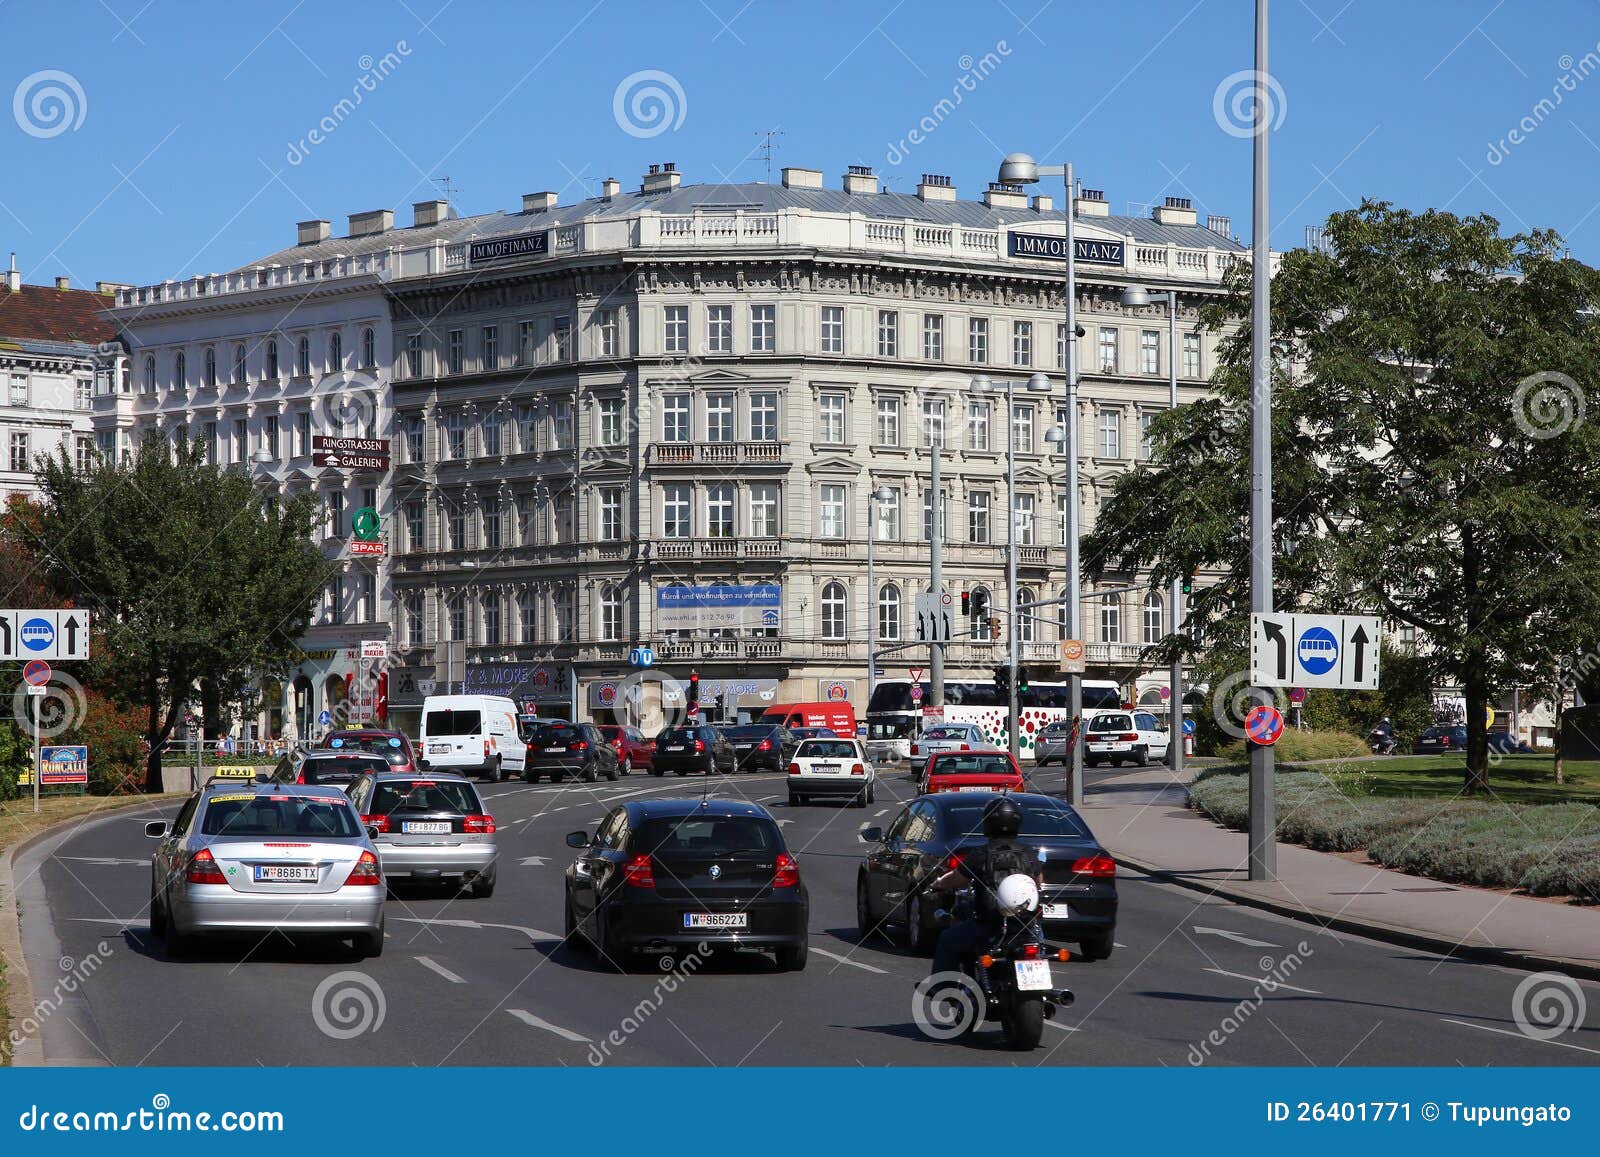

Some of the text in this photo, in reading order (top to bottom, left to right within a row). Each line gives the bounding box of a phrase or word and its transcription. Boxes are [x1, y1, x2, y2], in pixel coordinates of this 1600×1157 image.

[473, 237, 542, 258] IMMOFINANZ
[322, 438, 382, 451] RINGSTRASSEN
[341, 456, 382, 468] GALERIEN
[351, 543, 383, 552] SPAR
[682, 592, 694, 600] und
[696, 590, 734, 600] Wohnungen
[643, 652, 652, 665] U
[491, 665, 528, 684] MORE
[220, 767, 251, 776] TAXI
[262, 868, 316, 879] W 8686 TX
[692, 915, 744, 925] W 96622 X
